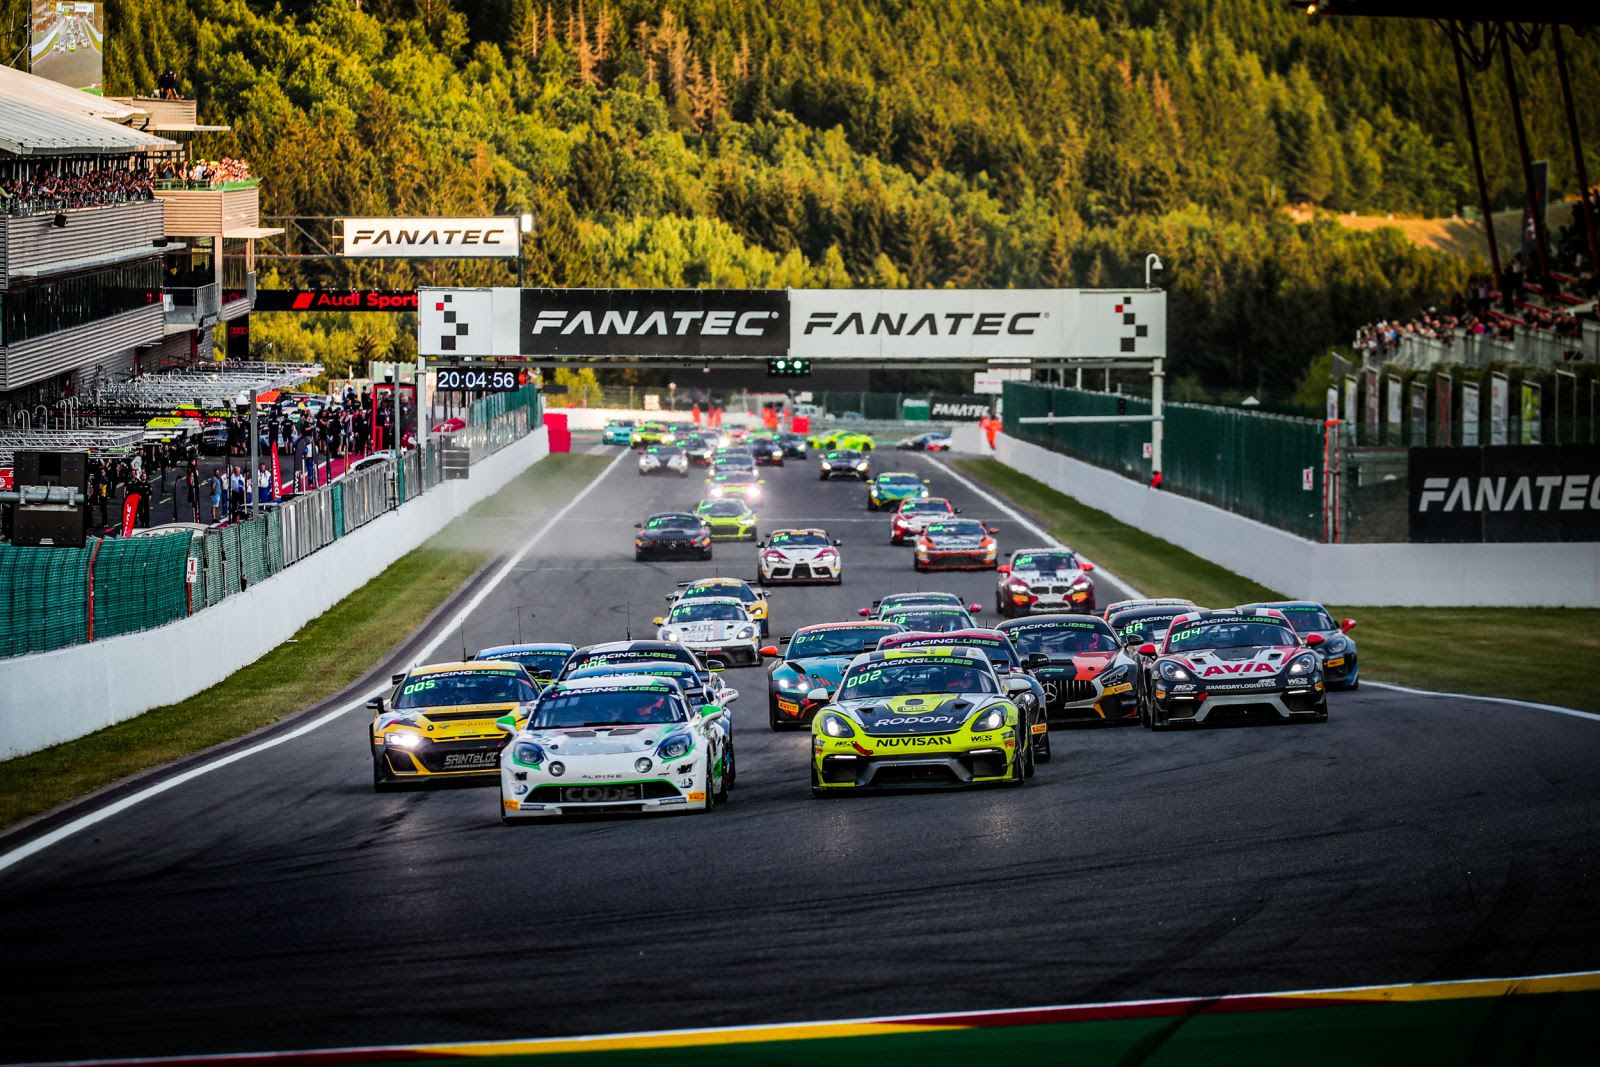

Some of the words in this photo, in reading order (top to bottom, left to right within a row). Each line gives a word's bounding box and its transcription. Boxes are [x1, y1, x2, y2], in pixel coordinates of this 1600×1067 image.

[352, 229, 505, 245] FANATEC
[317, 293, 360, 306] Audi
[367, 292, 418, 309] Sport
[532, 311, 772, 337] FANATEC
[804, 312, 1043, 336] FANATEC
[438, 371, 514, 388] 20:04:56
[1010, 622, 1095, 632] RACINGLUBES
[1191, 617, 1280, 627] RACINGLUBES
[1172, 628, 1200, 643] 004
[901, 639, 999, 648] RACINGLUBES
[486, 652, 567, 660] RACINGLUBES
[590, 652, 677, 662] RACINGLUBES
[867, 657, 973, 670] RACINGLUBES
[1203, 662, 1275, 677] AVIA
[421, 671, 517, 680] RACINGLUBES
[847, 670, 882, 688] 002
[560, 685, 669, 696] RACINGLUBES
[875, 717, 953, 727] RODOPI
[876, 737, 951, 747] NUVISAN
[565, 785, 636, 801] CODE
